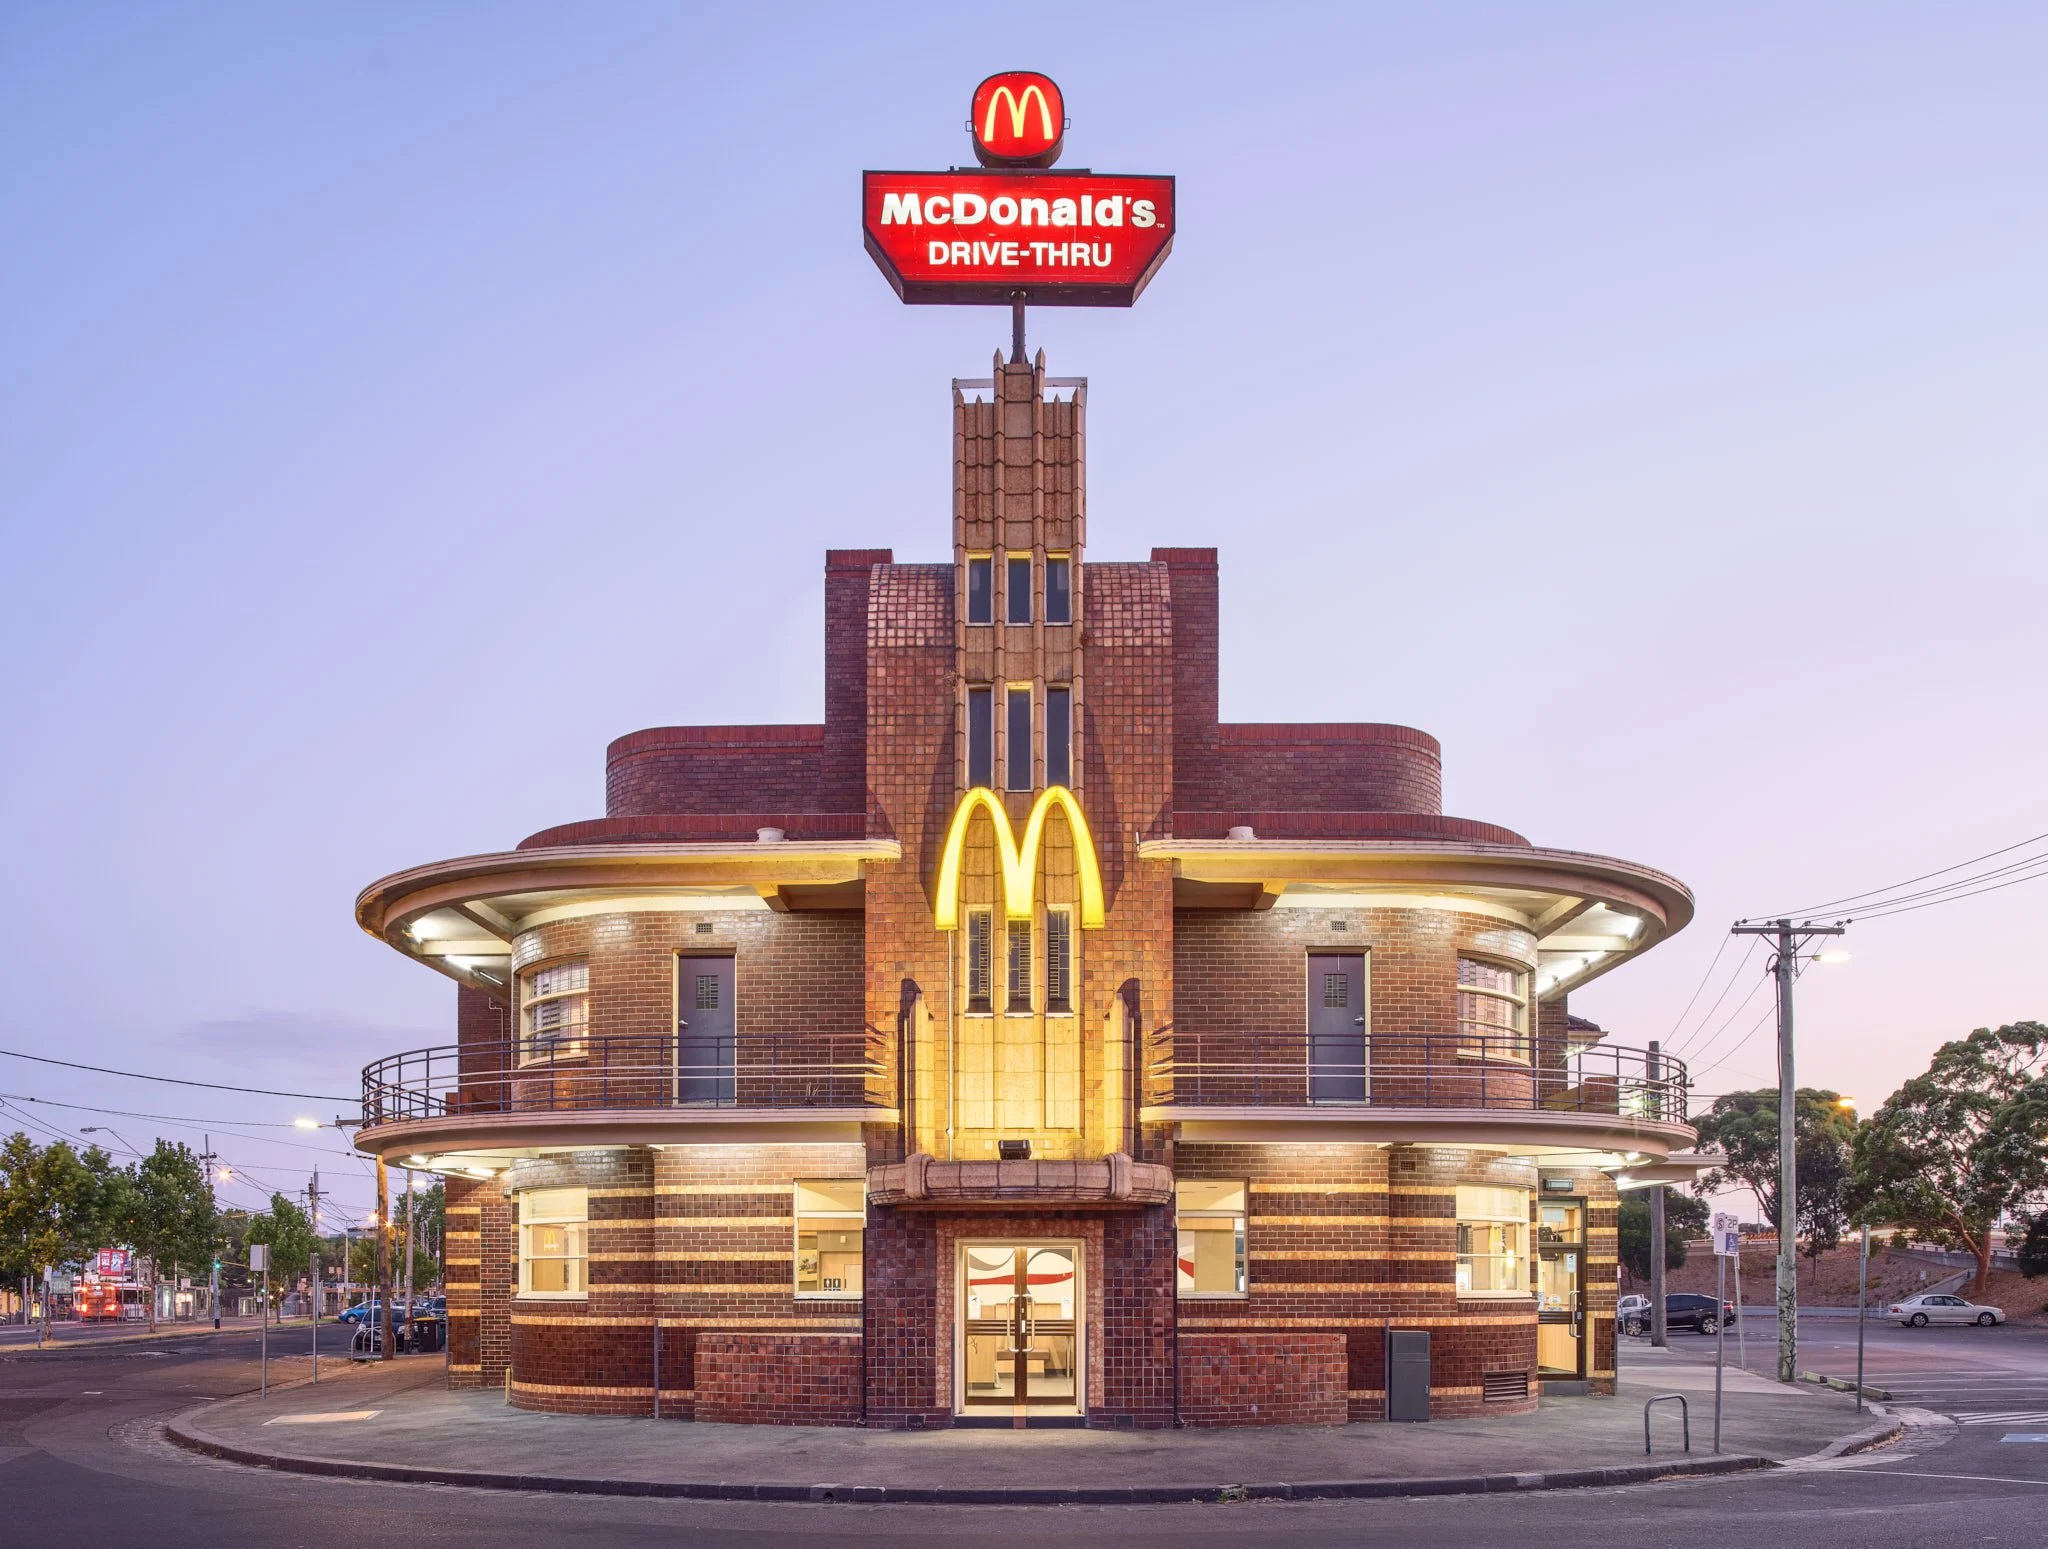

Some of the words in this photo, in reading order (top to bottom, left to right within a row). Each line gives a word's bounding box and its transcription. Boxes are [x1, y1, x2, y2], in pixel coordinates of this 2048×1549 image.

[984, 85, 1053, 142] M
[880, 193, 1156, 227] McDonald's
[929, 241, 1112, 267] DRIVE-THRU
[935, 785, 1105, 930] M
[1727, 1218, 1738, 1230] 2P
